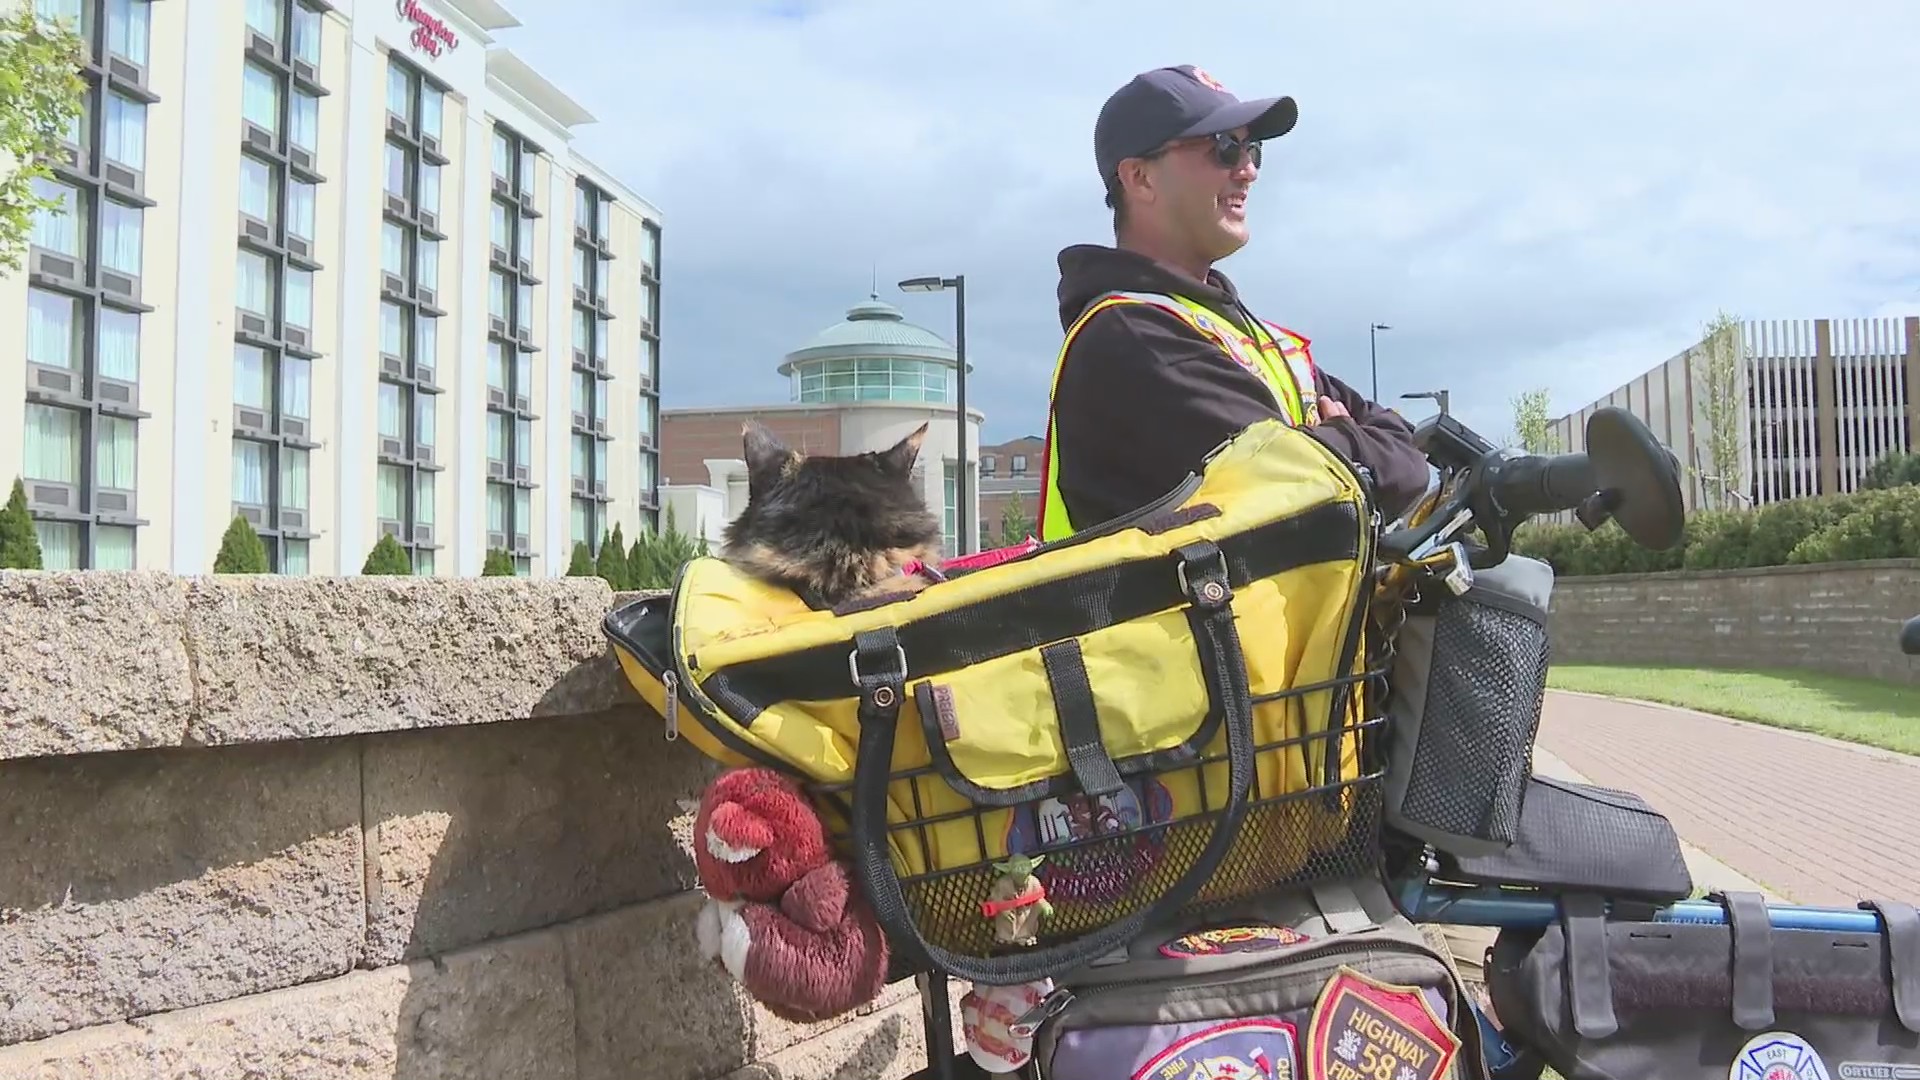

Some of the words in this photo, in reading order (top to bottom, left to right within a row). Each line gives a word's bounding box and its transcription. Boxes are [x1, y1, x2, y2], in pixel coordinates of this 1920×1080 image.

[396, 0, 458, 49] Hampton
[410, 26, 442, 57] Inn
[1347, 1007, 1430, 1069] HIGHWAY
[1766, 1049, 1786, 1060] EAST
[1358, 1042, 1397, 1080] 58
